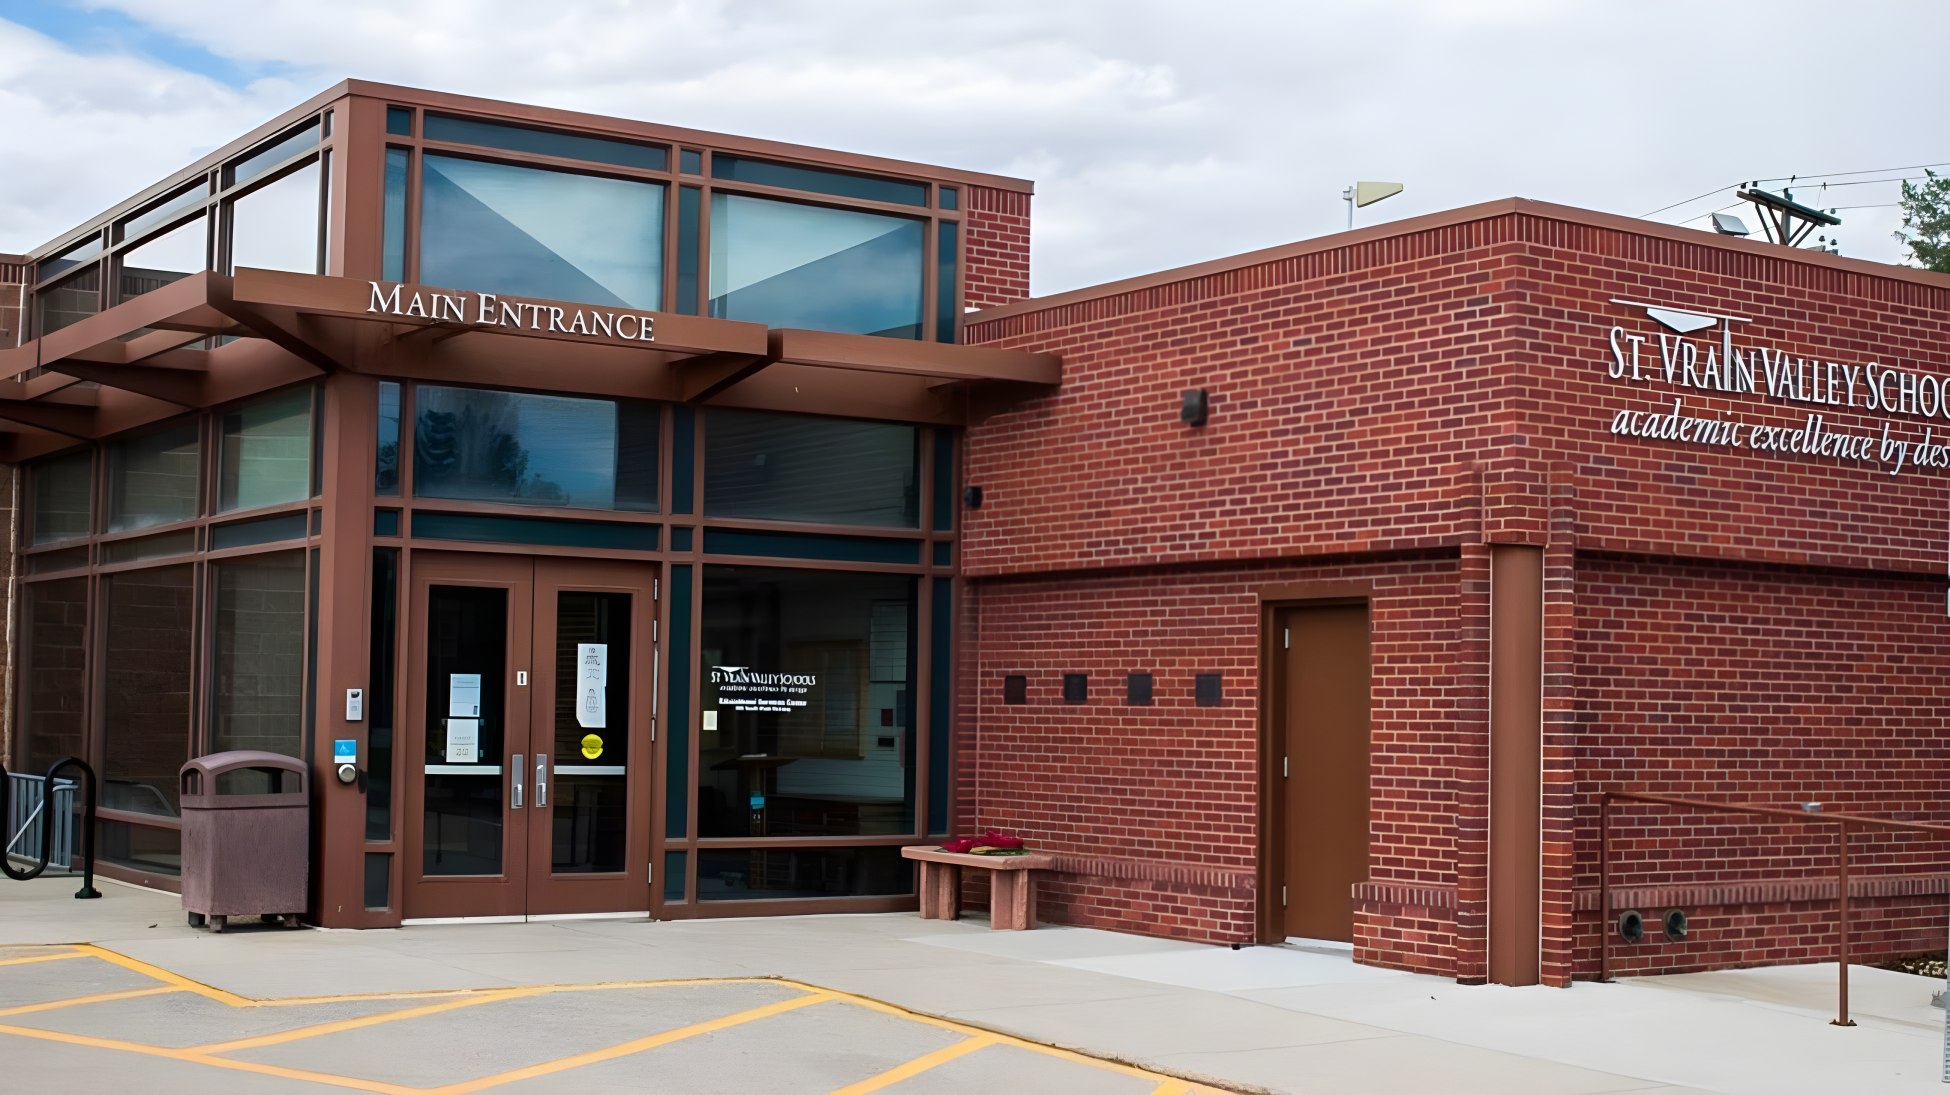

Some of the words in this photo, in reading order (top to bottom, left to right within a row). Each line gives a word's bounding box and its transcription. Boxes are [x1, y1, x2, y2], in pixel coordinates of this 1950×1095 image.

[367, 281, 466, 322] MAIN
[476, 292, 656, 342] ENTRANCE
[1609, 326, 1651, 381] ST.
[1658, 318, 1756, 394] VRAIN
[1760, 347, 1860, 407] VALLEY
[1611, 398, 1745, 447] academic
[1750, 414, 1873, 460] excellence
[1880, 422, 1907, 476] by
